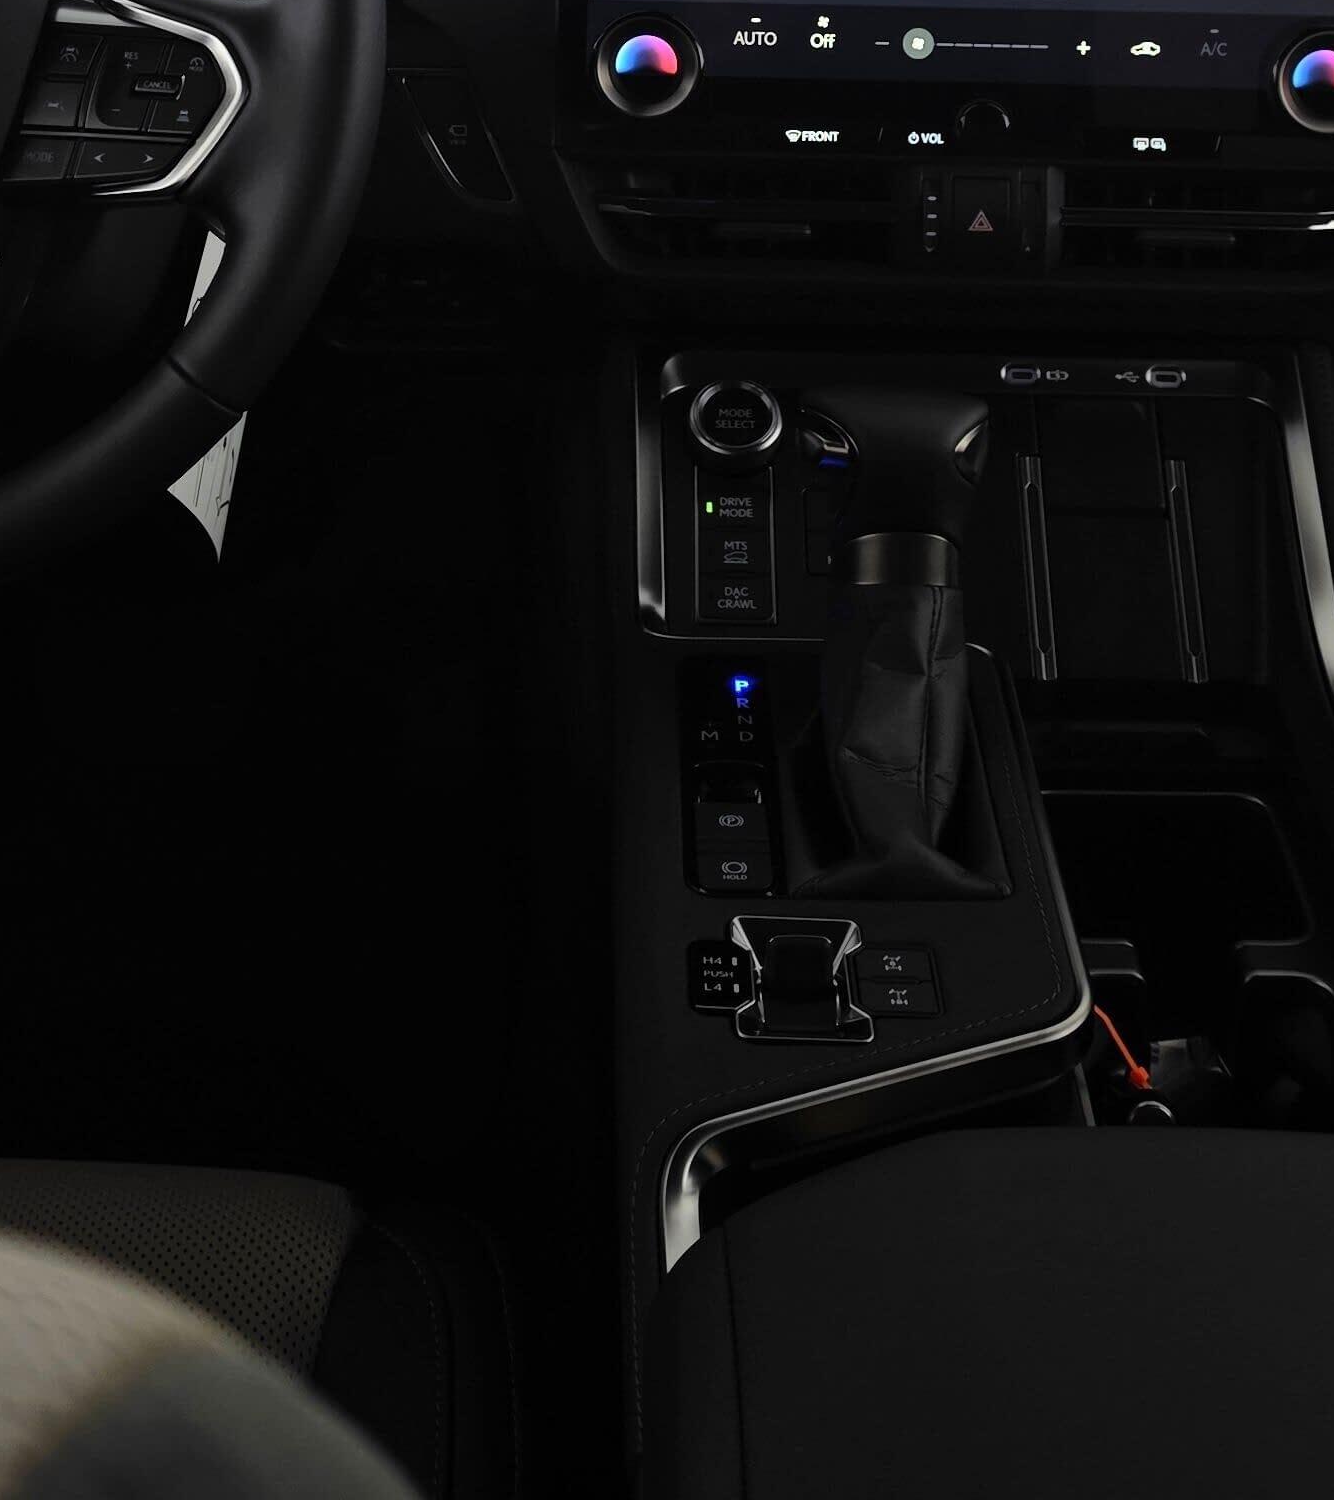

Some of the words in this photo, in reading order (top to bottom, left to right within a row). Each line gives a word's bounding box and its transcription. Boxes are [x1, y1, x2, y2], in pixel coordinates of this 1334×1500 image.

[733, 30, 777, 47] AUTO
[810, 32, 836, 49] Off
[1200, 41, 1228, 57] A/C
[801, 130, 840, 143] FRONT
[921, 133, 945, 145] VOL
[718, 408, 754, 418] MODE
[715, 419, 756, 429] SELECT
[719, 496, 753, 507] DRIVE
[719, 508, 754, 518] MODE
[723, 540, 748, 551] MTS
[724, 586, 749, 597] DAC
[717, 599, 758, 610] CRAWL
[734, 679, 750, 692] P
[736, 698, 750, 709] R
[737, 715, 753, 725] N
[700, 730, 719, 741] M
[738, 731, 754, 742] D
[722, 873, 748, 881] HOLD
[702, 955, 723, 966] H4
[703, 969, 735, 979] PUSH
[704, 982, 723, 993] L4
